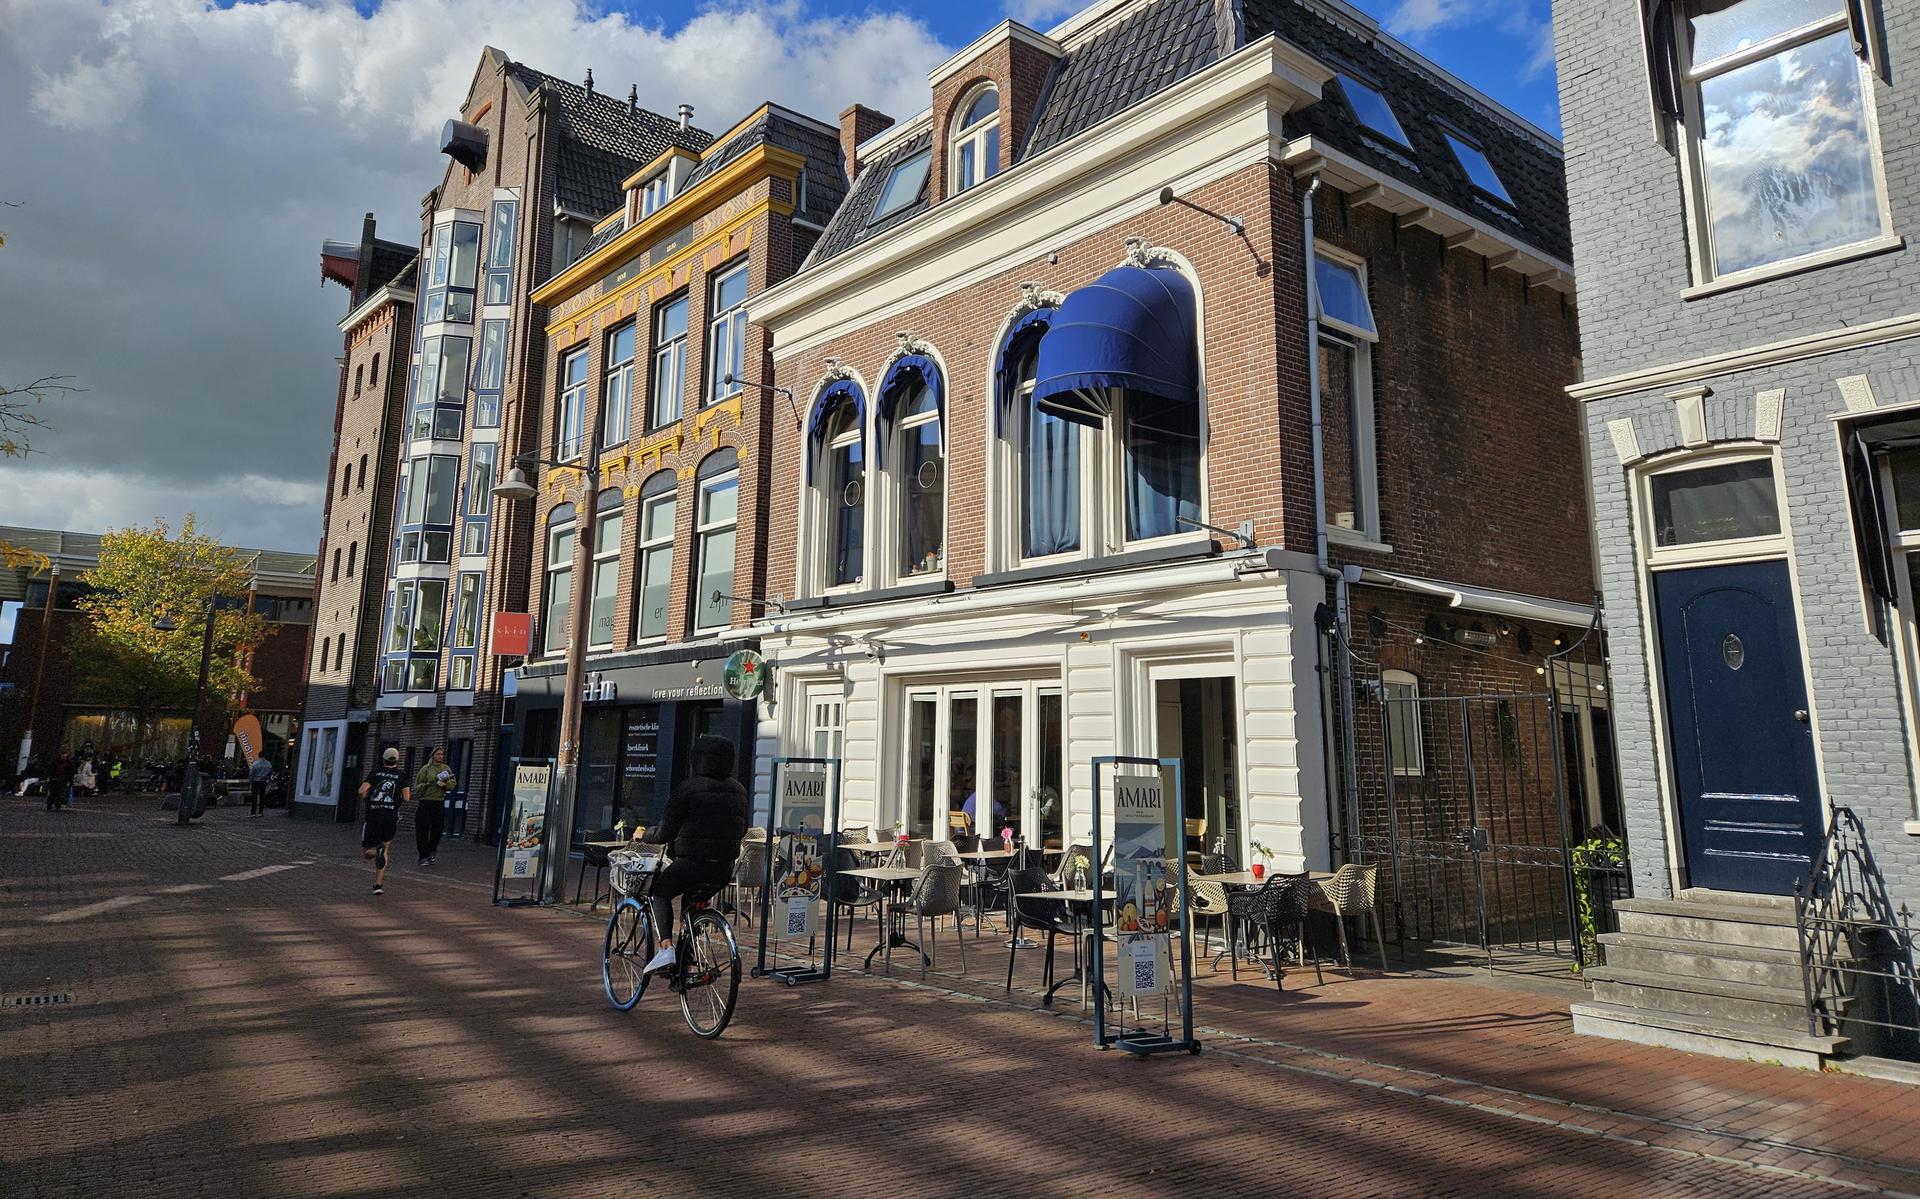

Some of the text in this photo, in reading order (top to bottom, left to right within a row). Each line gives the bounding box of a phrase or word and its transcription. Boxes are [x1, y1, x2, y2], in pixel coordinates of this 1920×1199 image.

[654, 606, 664, 619] er
[599, 616, 614, 631] mag
[651, 684, 723, 700] love your reflection
[516, 772, 547, 784] AMARI
[785, 780, 825, 797] AMARI
[1117, 787, 1161, 808] AMARI
